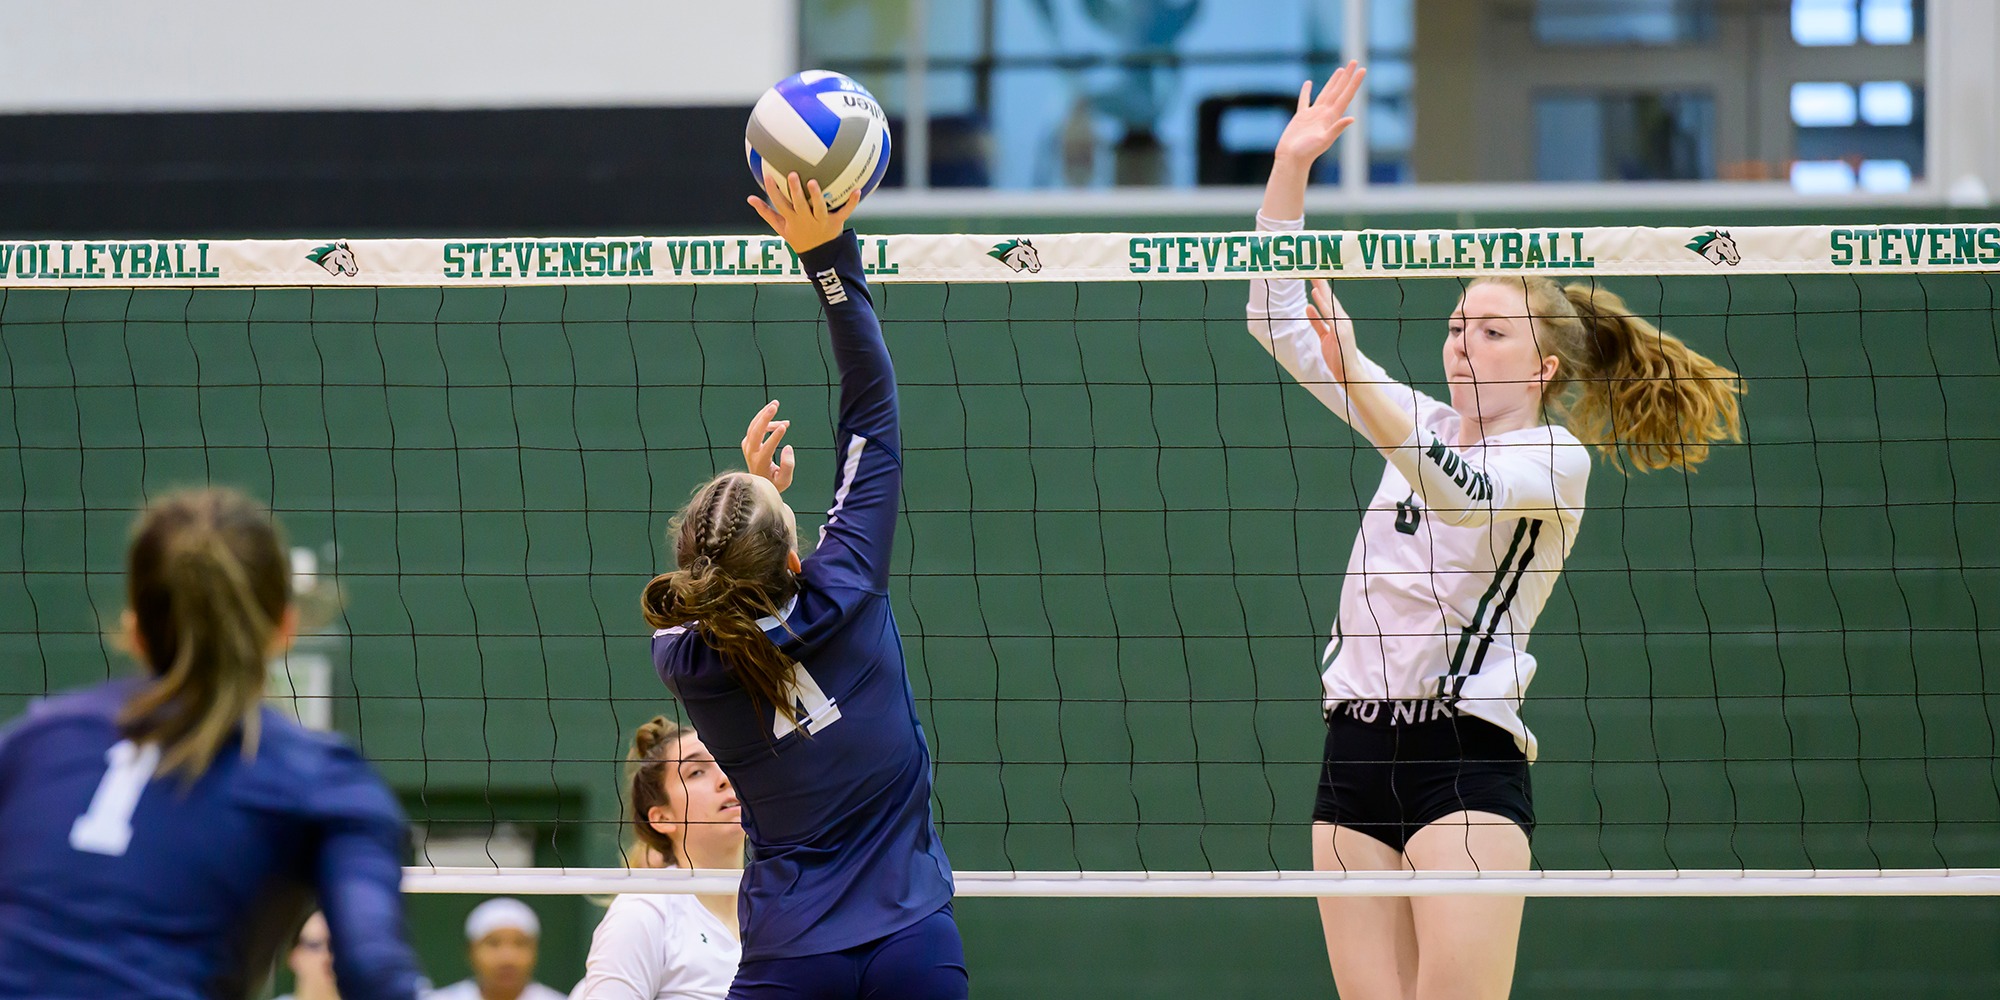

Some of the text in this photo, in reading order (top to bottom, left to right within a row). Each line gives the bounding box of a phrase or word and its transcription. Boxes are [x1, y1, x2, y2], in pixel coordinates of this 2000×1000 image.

[0, 243, 220, 279] VOLLEYBALL
[443, 238, 899, 278] STEVENSON VOLLEYLL
[1129, 232, 1595, 273] STEVENSON VOLLEYBALL
[1831, 227, 2000, 265] STEVENS
[816, 267, 849, 305] PENN
[1338, 699, 1471, 726] RO NIK
[68, 739, 160, 857] 1
